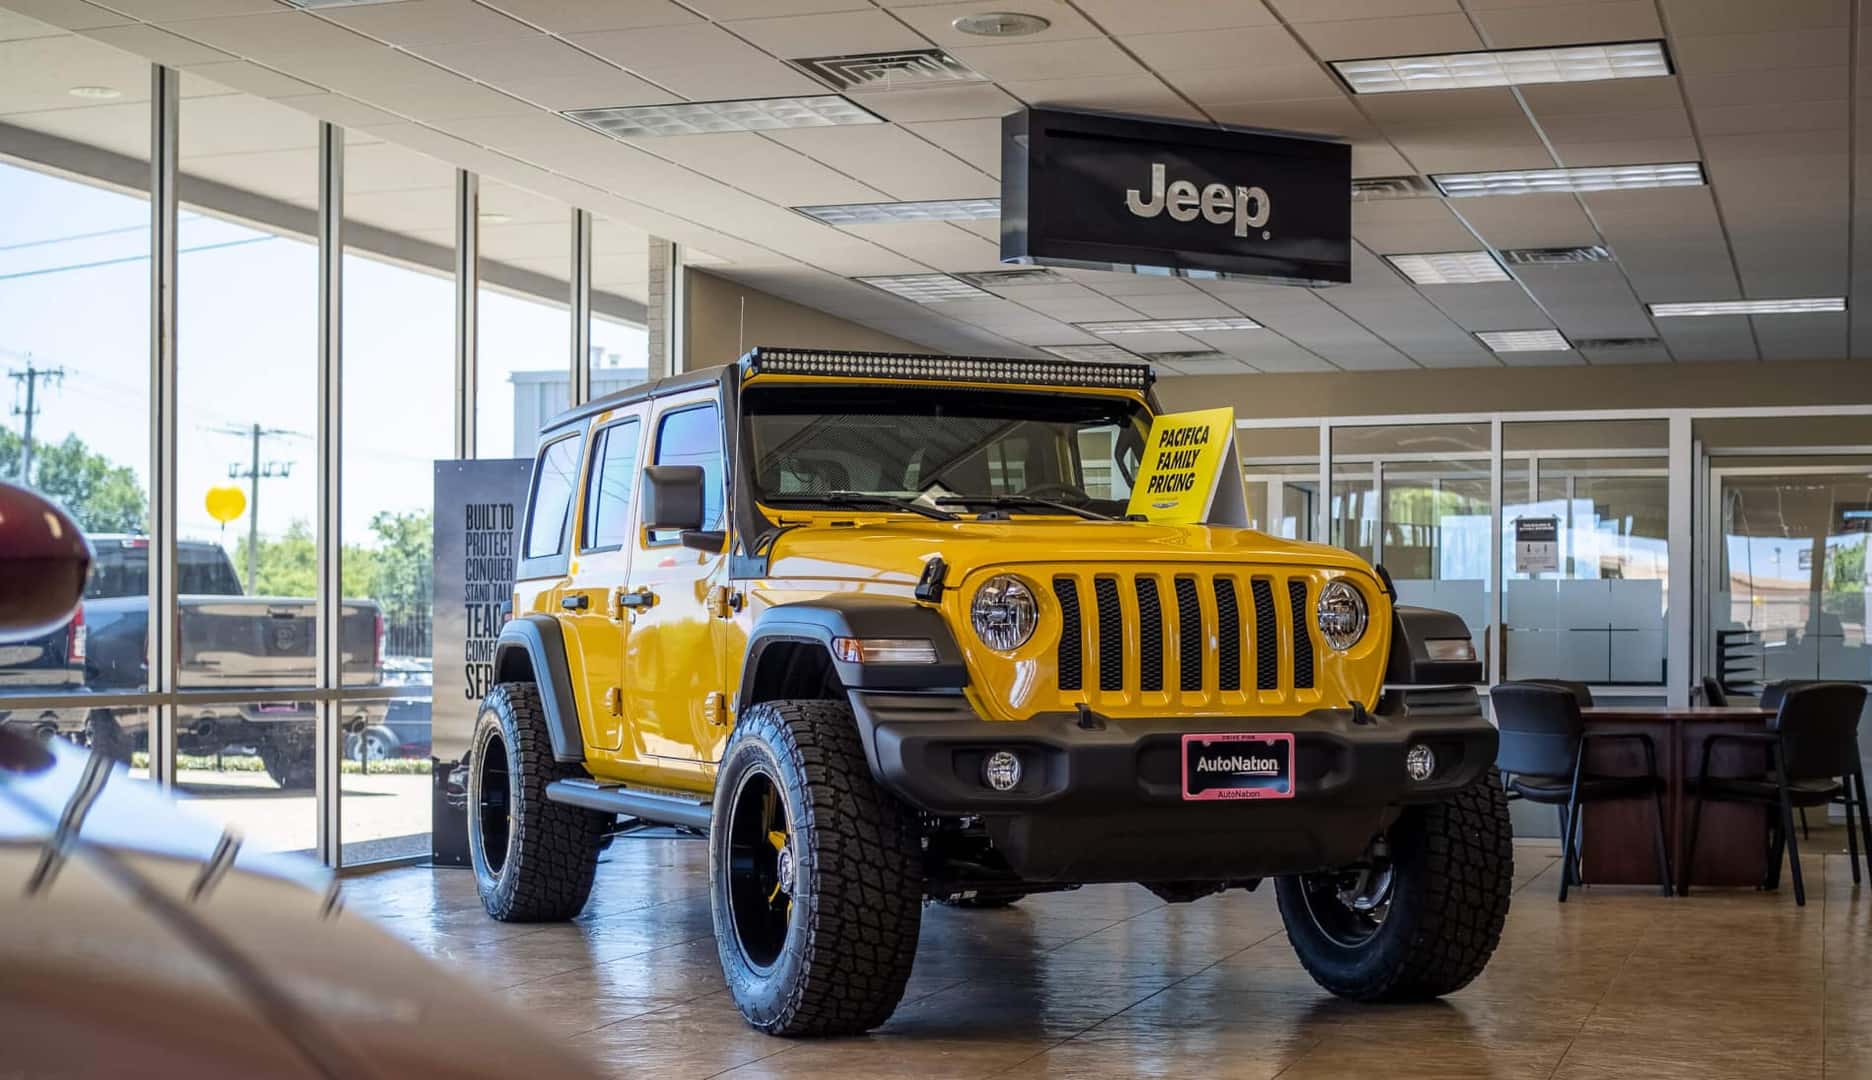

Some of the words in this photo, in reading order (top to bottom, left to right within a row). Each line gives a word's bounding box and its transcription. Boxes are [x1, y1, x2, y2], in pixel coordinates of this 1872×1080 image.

[1126, 163, 1270, 237] Jeep
[1159, 425, 1210, 448] PACIFICA
[1156, 449, 1201, 471] FAMILY
[1147, 472, 1196, 494] PRICING
[465, 504, 497, 530] BUILT
[498, 504, 513, 530] TO
[465, 532, 513, 556] PROTECT
[465, 558, 513, 583] CONQUER
[465, 583, 490, 601] STAND
[465, 603, 502, 638] TEAC
[465, 640, 498, 662] COMF
[465, 664, 494, 699] SER
[1197, 755, 1279, 772] AutoNation
